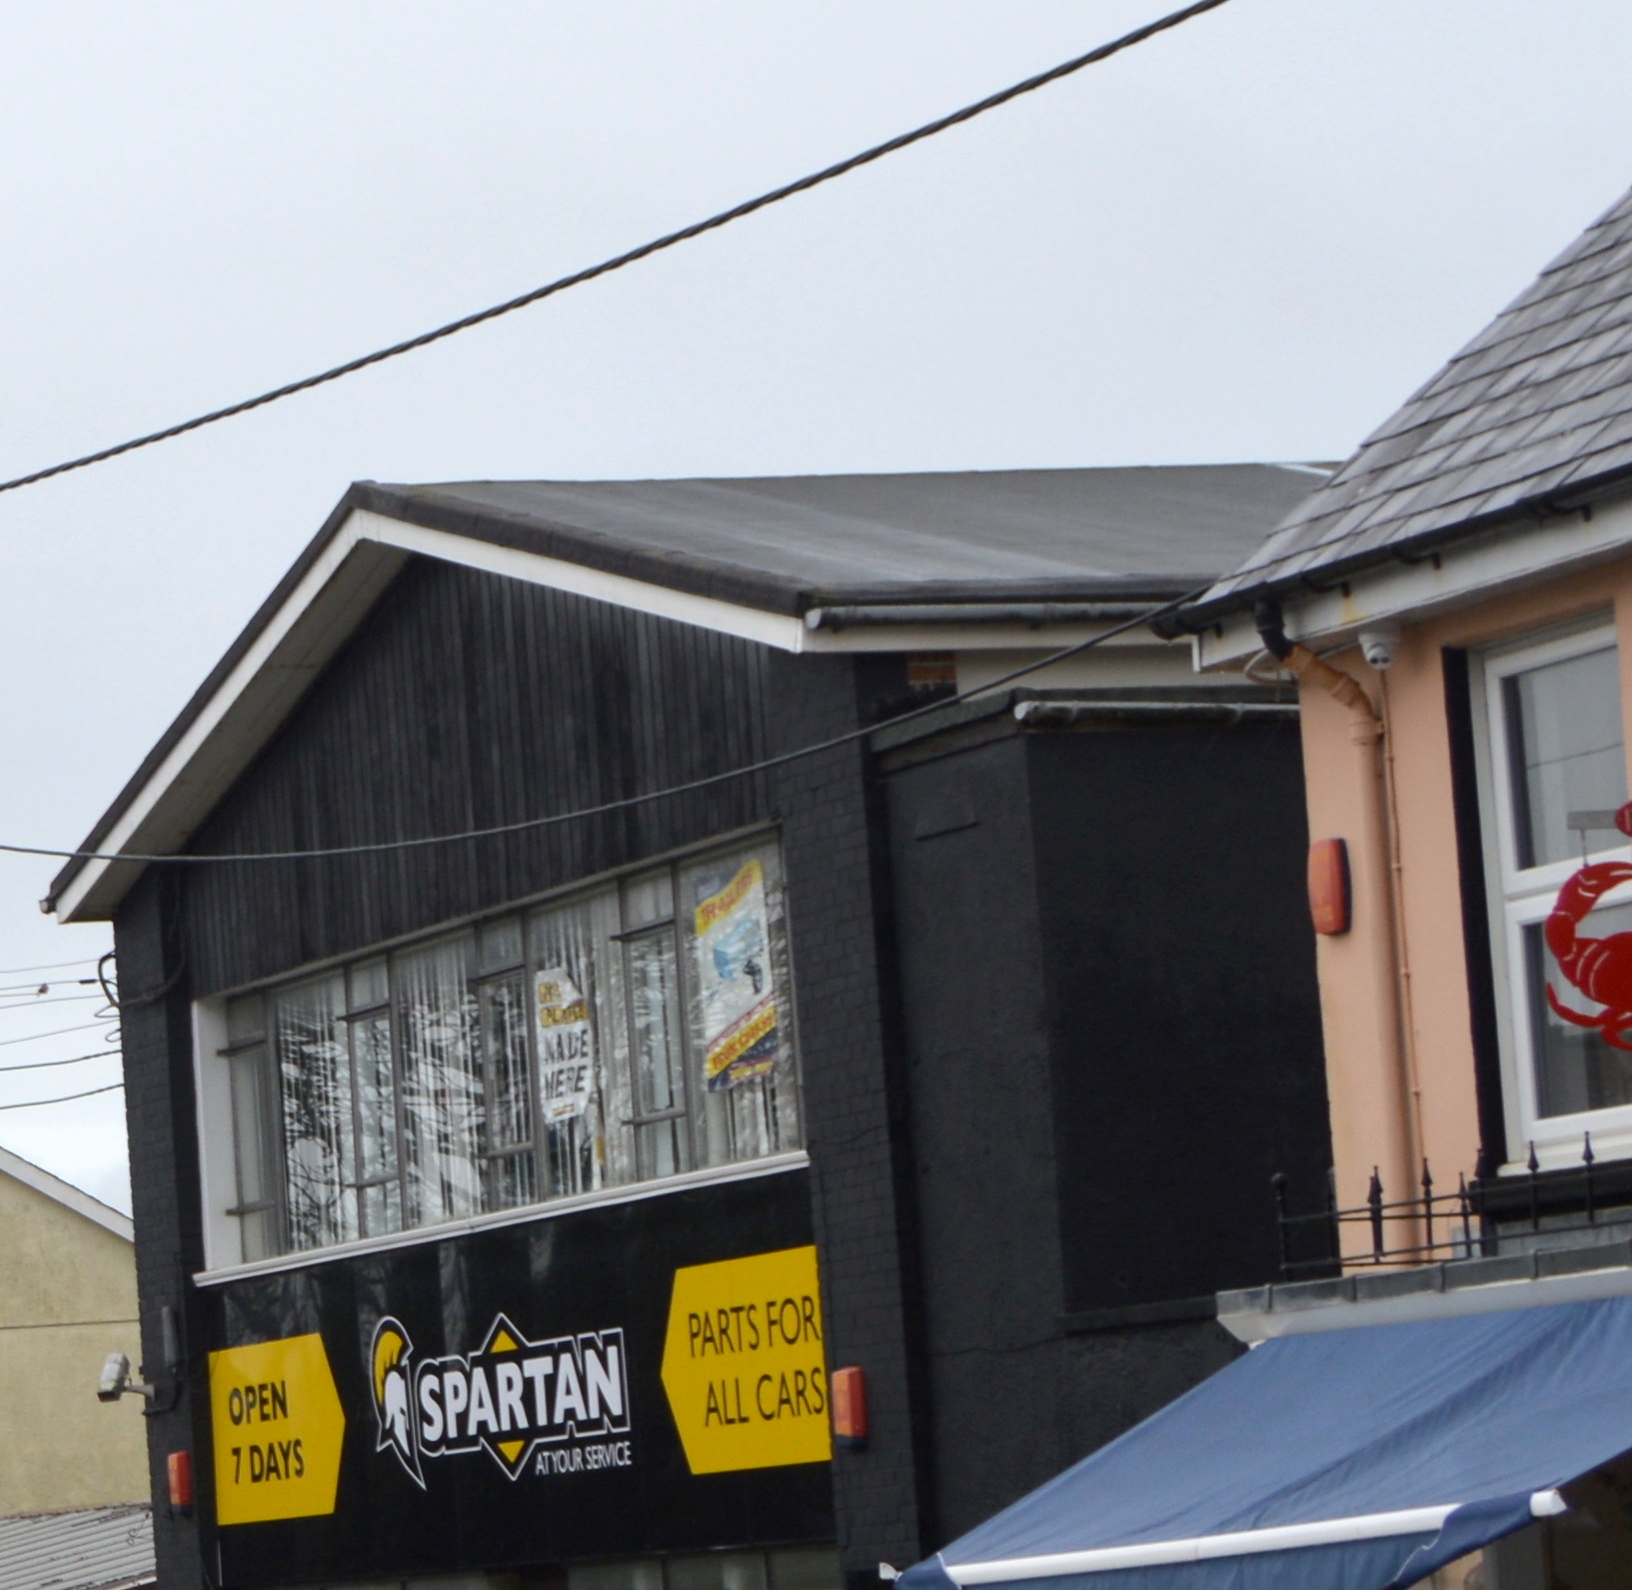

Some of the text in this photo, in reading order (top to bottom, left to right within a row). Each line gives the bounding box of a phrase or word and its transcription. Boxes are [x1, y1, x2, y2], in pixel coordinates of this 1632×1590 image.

[689, 1295, 823, 1358] PARTS FOR
[229, 1380, 288, 1426] OPEN
[419, 1345, 624, 1442] SPARTAN
[705, 1367, 825, 1428] ALL CARS
[231, 1438, 305, 1485] 7 DAYS
[536, 1441, 633, 1476] AT YOUR SERVICE
